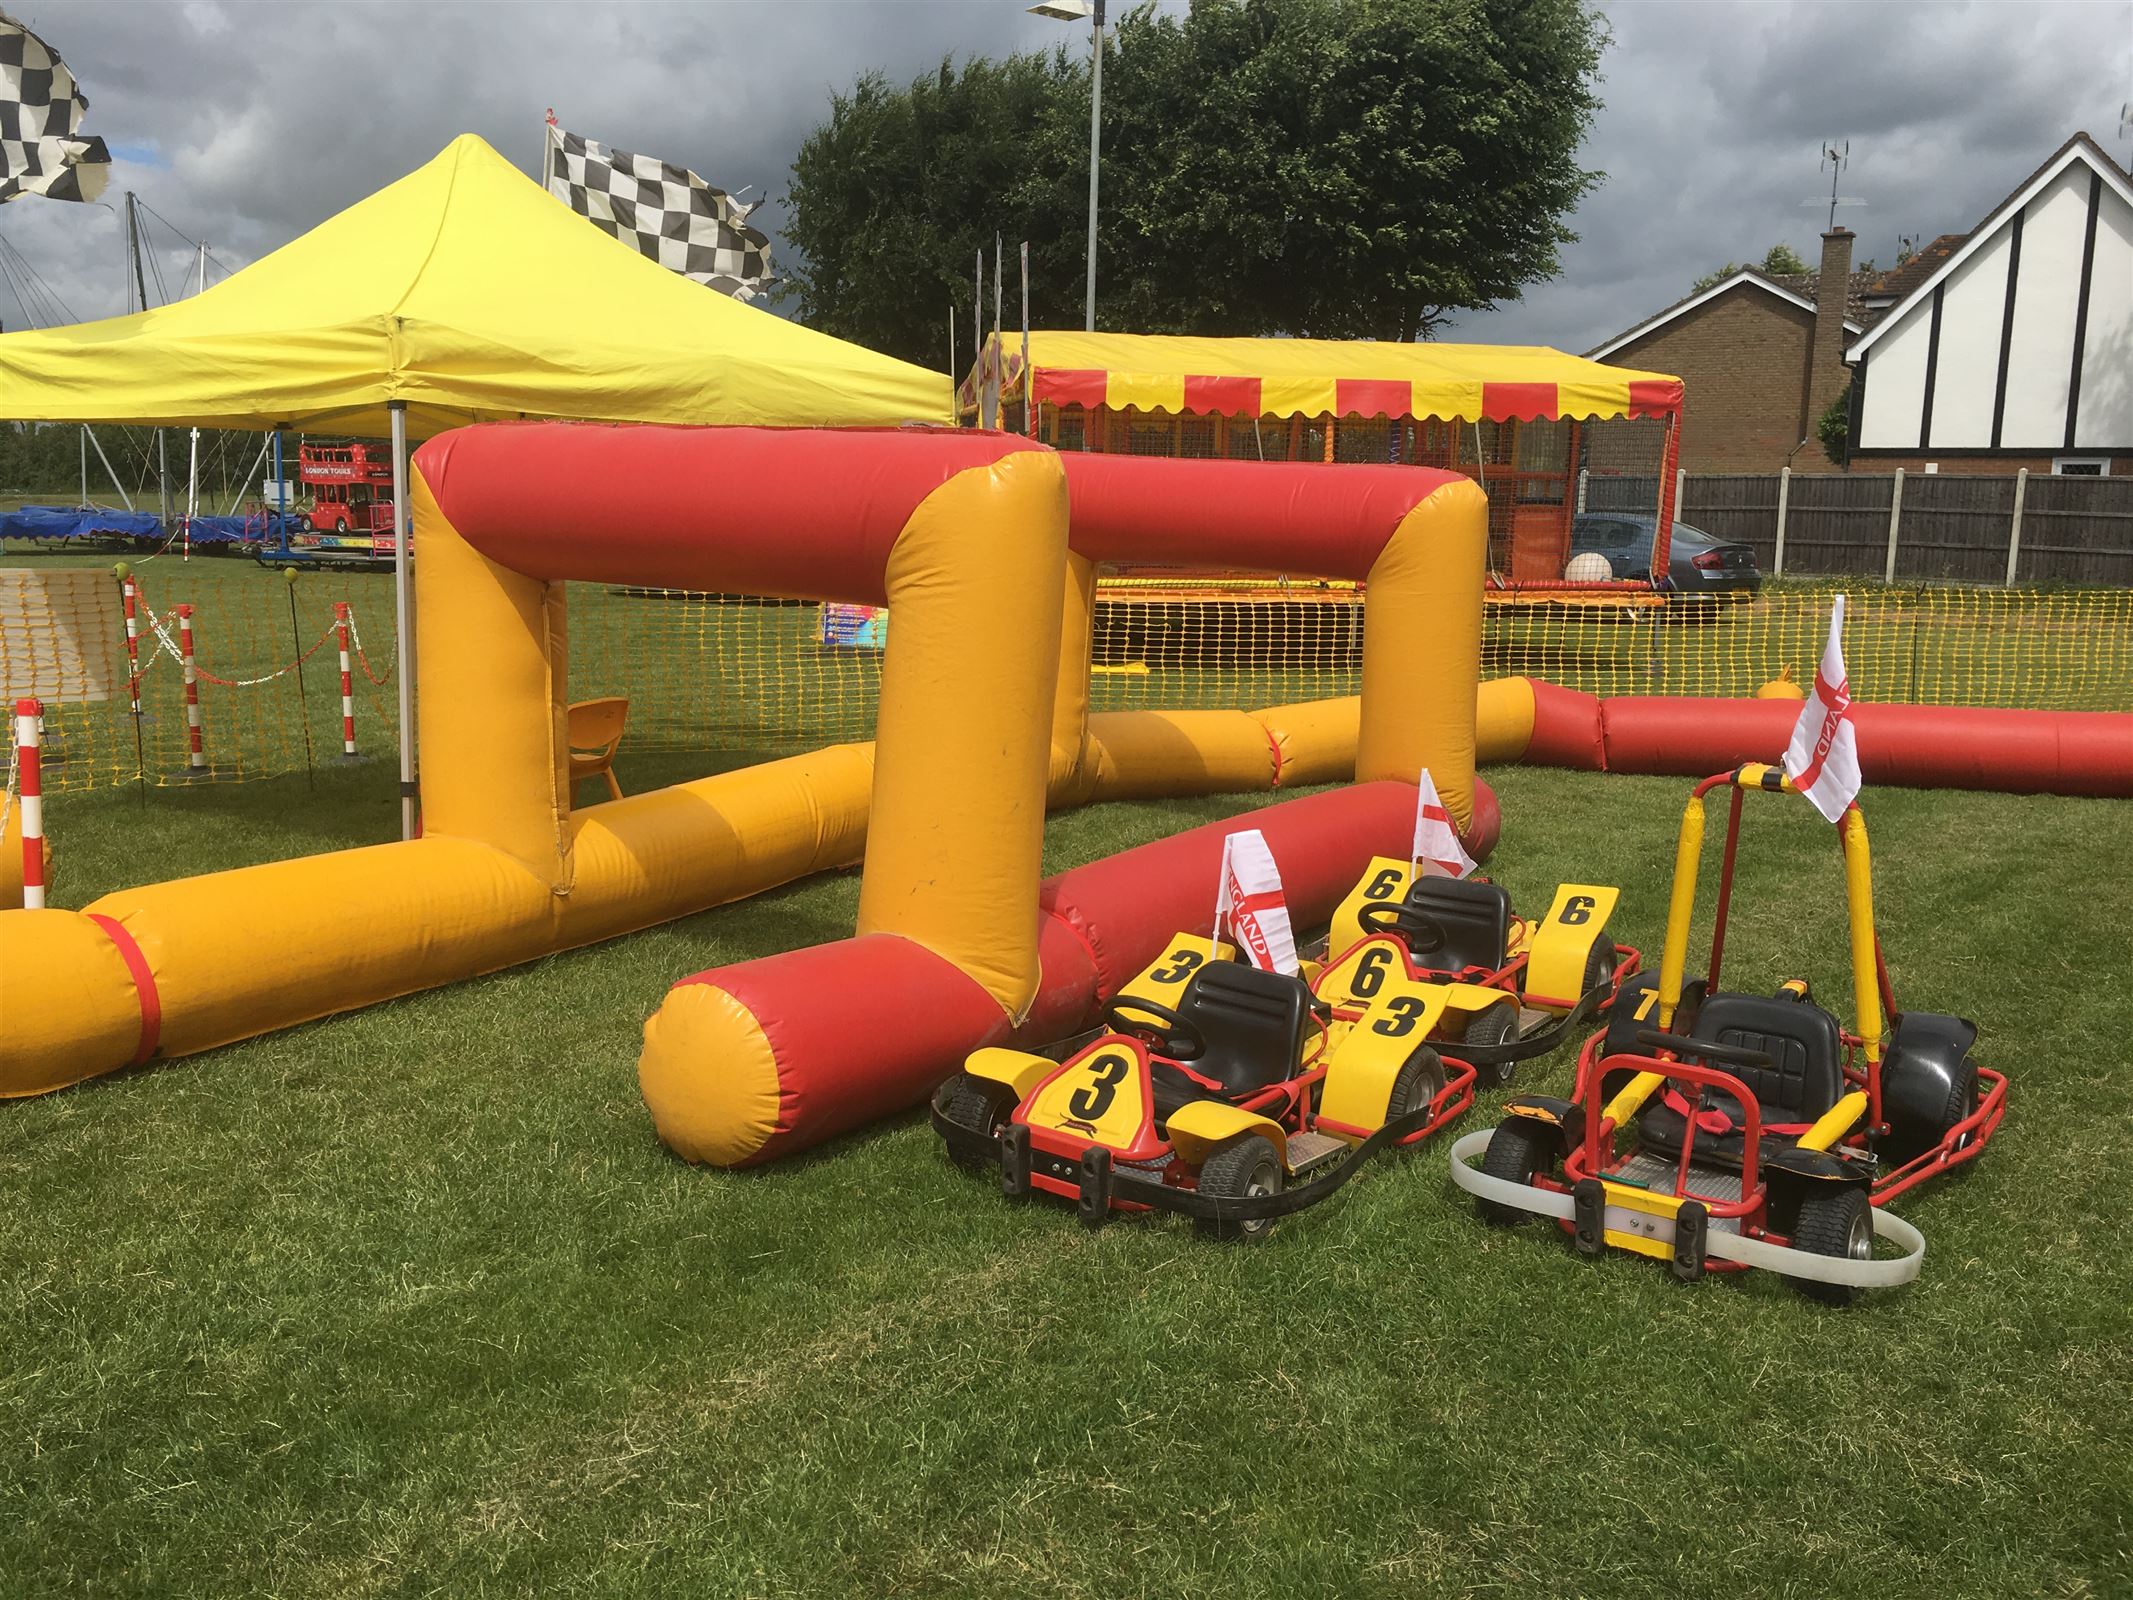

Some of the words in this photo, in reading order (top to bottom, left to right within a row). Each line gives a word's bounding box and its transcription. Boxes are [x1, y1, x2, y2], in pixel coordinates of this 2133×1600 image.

[305, 467, 329, 475] LONDON
[330, 467, 351, 475] TOURS
[1363, 868, 1403, 900] 6
[1228, 868, 1267, 956] NGLAND
[1558, 896, 1595, 925] 6
[1149, 949, 1204, 984] 3
[1350, 947, 1394, 999] 6
[1371, 996, 1426, 1037] 3
[1632, 988, 1660, 1021] 7
[1069, 1053, 1129, 1121] 3
